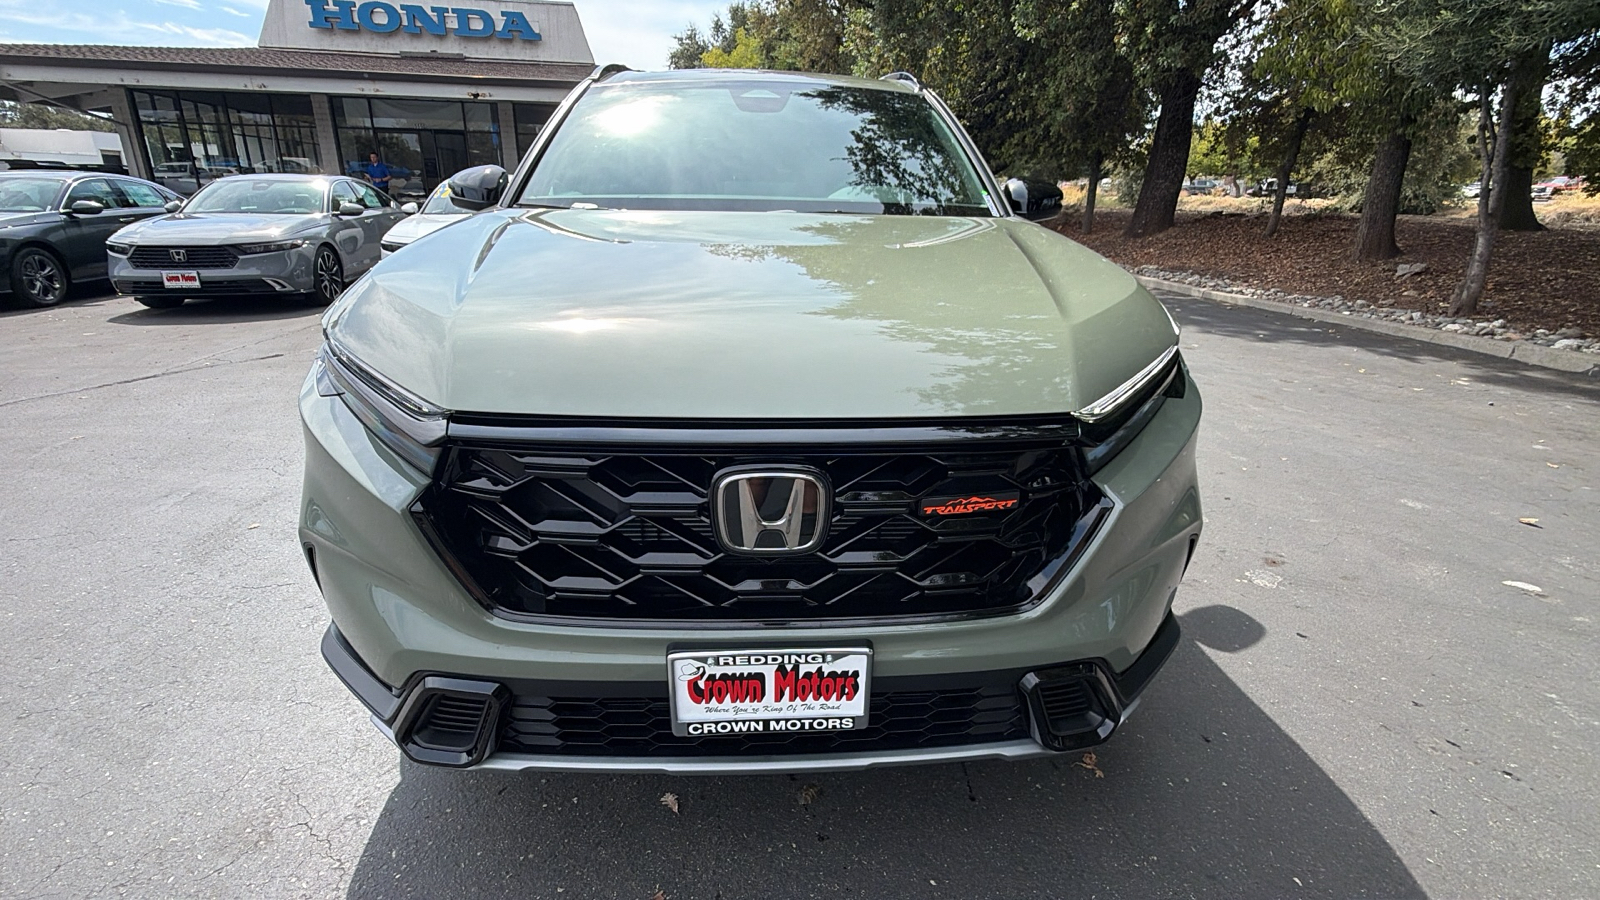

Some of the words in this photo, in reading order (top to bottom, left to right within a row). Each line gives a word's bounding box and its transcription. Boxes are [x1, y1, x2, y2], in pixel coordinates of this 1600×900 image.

[305, 0, 542, 41] HONDA
[923, 499, 1018, 515] TRAILSPORT
[719, 654, 823, 666] REDDING
[687, 667, 766, 704] Crown
[774, 664, 860, 703] Motors
[704, 706, 730, 714] Where
[732, 705, 760, 716] You're
[762, 705, 783, 713] King
[786, 704, 799, 713] Of
[801, 703, 816, 711] The
[818, 703, 842, 711] Road
[688, 721, 763, 735] CROWN
[769, 718, 854, 732] MOTORS
